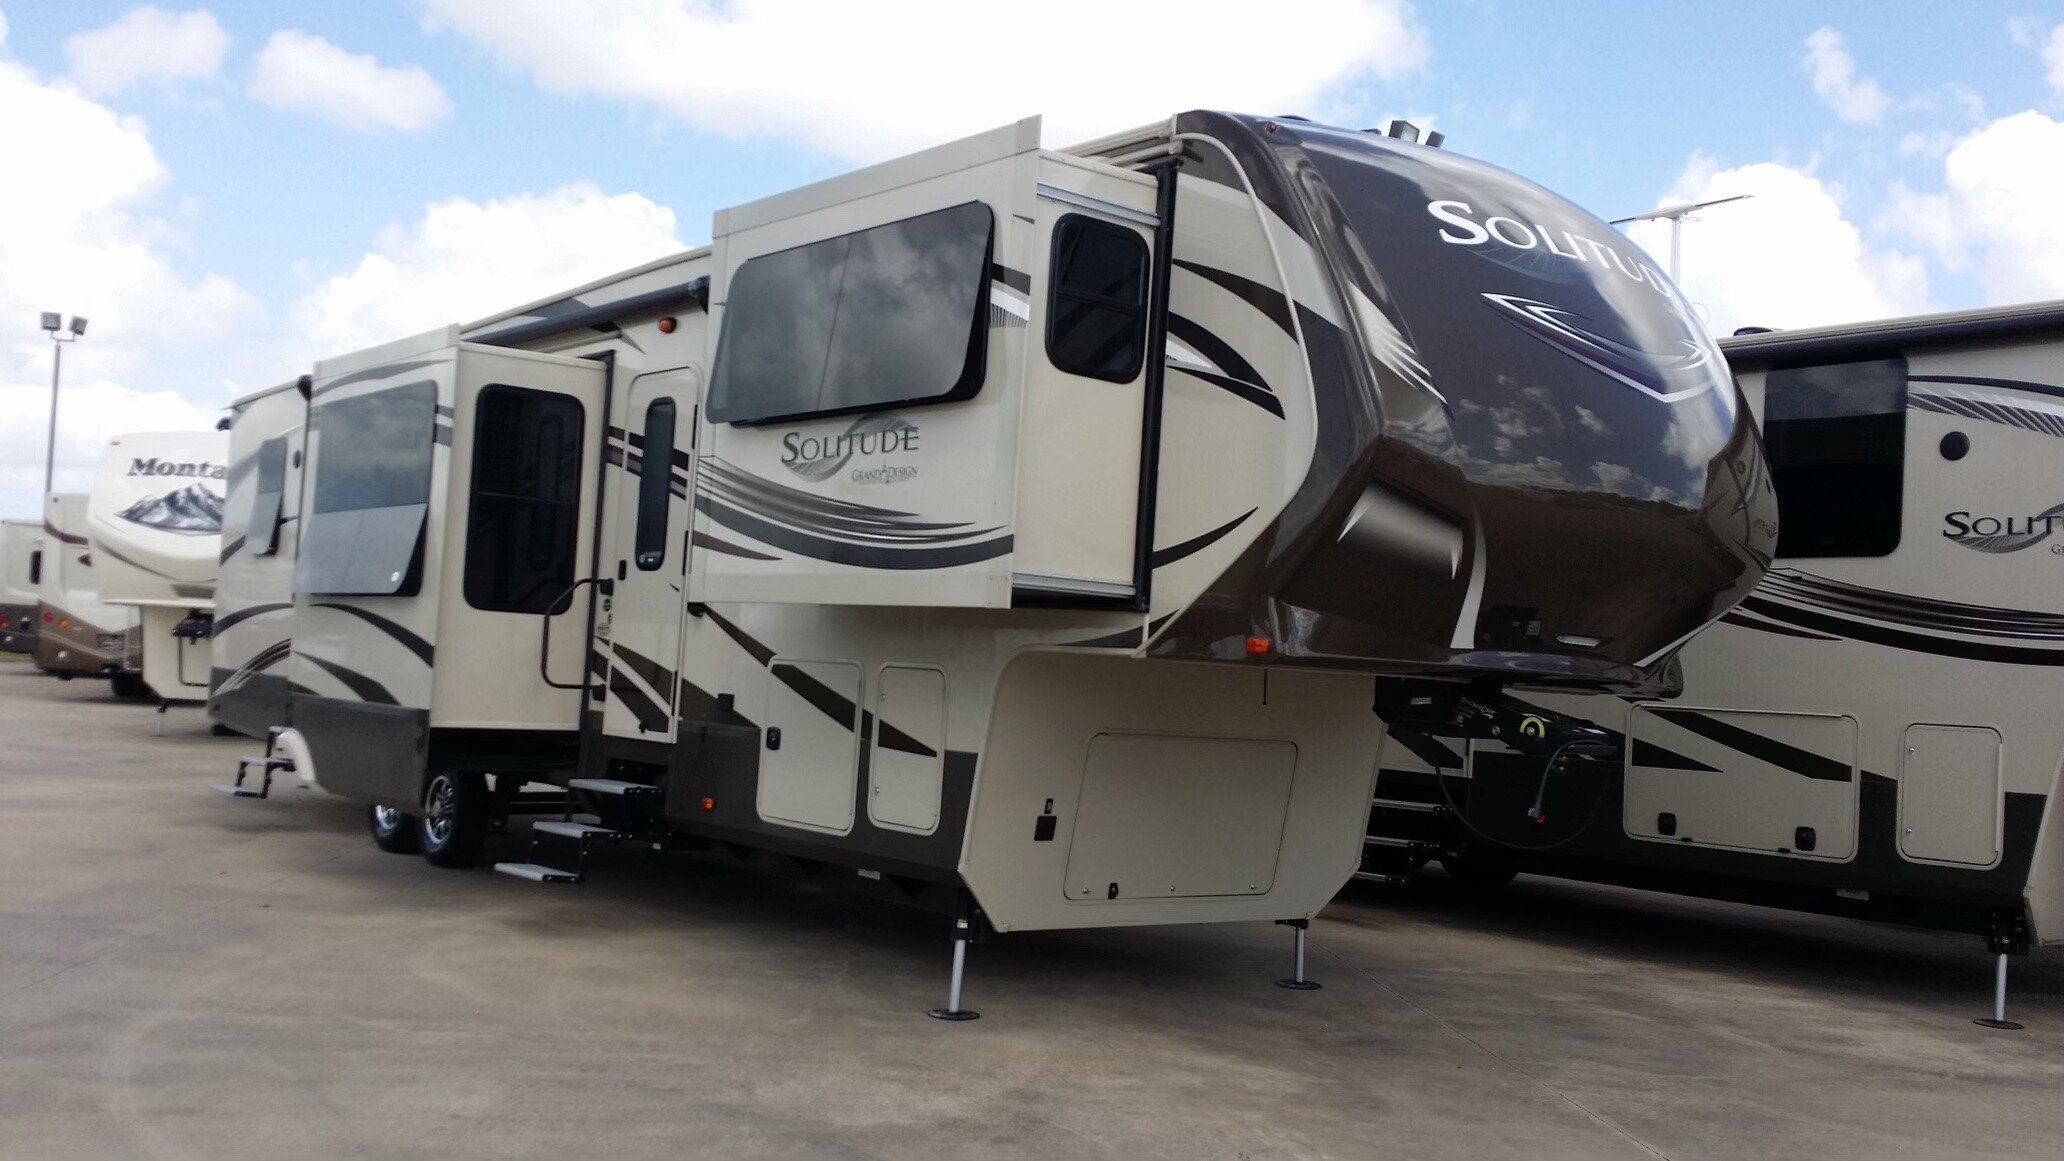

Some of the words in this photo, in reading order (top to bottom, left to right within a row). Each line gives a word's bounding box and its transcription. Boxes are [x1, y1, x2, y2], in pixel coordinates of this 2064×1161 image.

[1427, 200, 1673, 298] SOLITUD
[780, 426, 920, 463] SOLITUDE
[126, 457, 228, 480] Monta
[852, 468, 881, 483] GRAND
[888, 465, 918, 480] DESIGN
[1942, 511, 2064, 537] SOLIT
